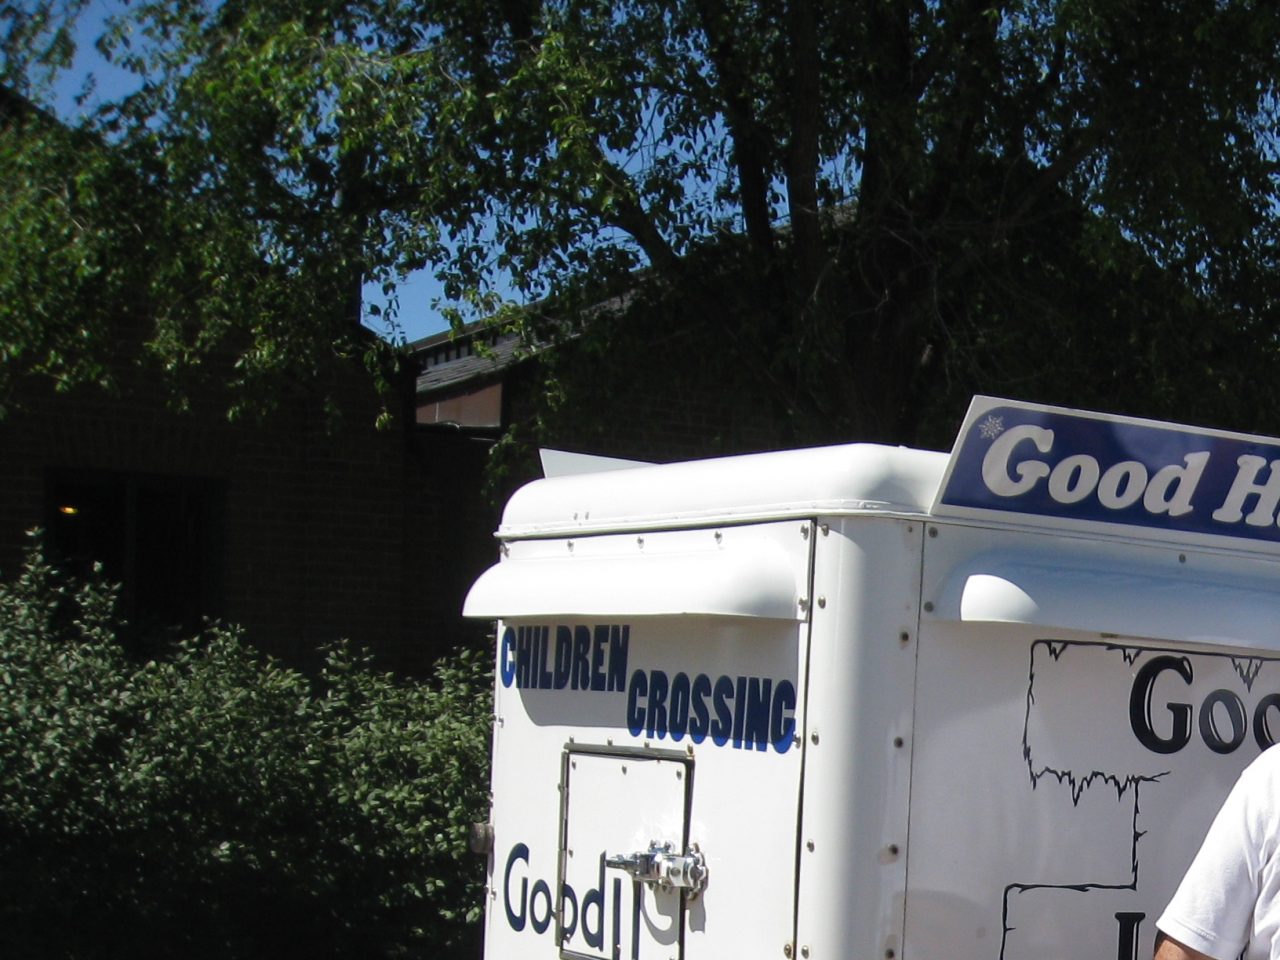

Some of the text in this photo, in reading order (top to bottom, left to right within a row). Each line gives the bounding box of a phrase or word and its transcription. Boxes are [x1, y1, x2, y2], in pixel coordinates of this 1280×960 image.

[982, 424, 1210, 516] Good
[500, 624, 630, 693] CHILDREN
[626, 668, 797, 754] CROSSING
[504, 842, 607, 952] Good
